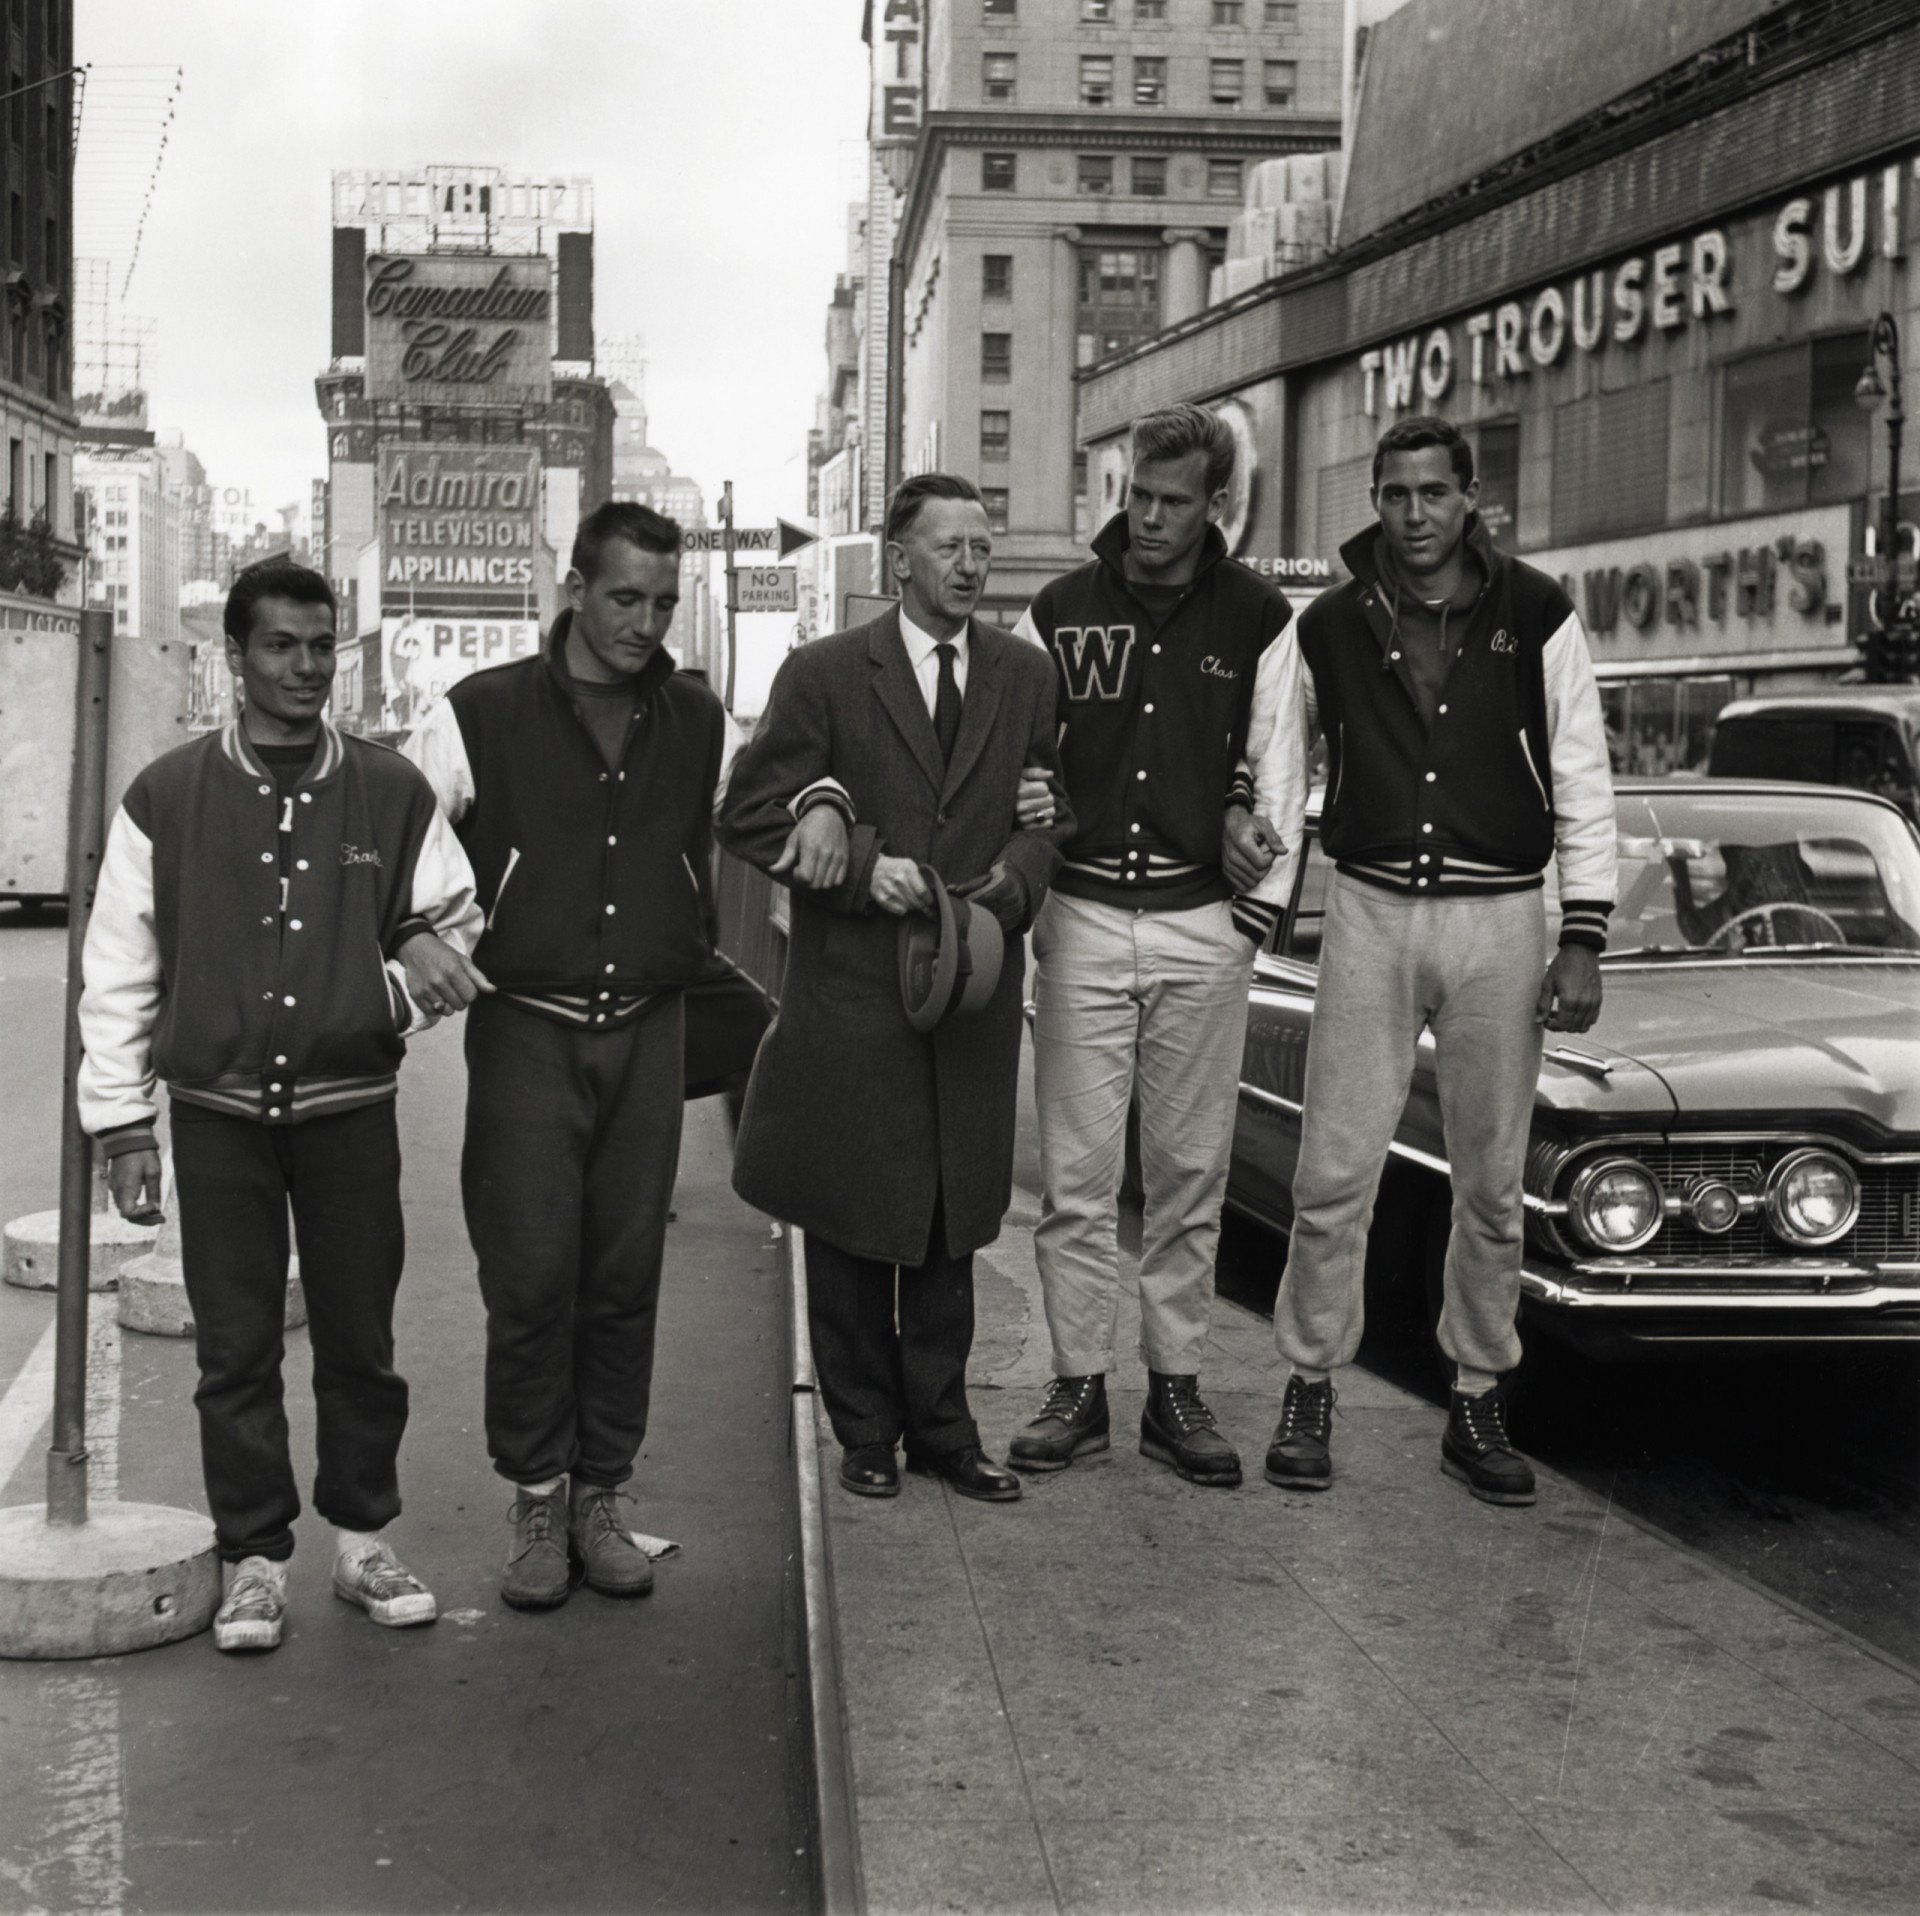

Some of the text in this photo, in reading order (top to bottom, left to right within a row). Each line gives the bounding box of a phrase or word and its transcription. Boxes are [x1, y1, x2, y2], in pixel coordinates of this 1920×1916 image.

[365, 254, 549, 320] Canadian
[1360, 157, 1920, 416] TWO TROUSER SUI
[401, 320, 519, 382] Club
[382, 453, 540, 508] Admiral
[389, 519, 532, 547] TELEVISION
[683, 531, 773, 550] ONE WAY
[387, 556, 533, 584] APPLIANCES
[752, 573, 780, 587] NO
[1237, 556, 1329, 577] TERION
[742, 590, 790, 602] PARKING
[433, 624, 527, 658] PEPE
[1055, 625, 1135, 700] W
